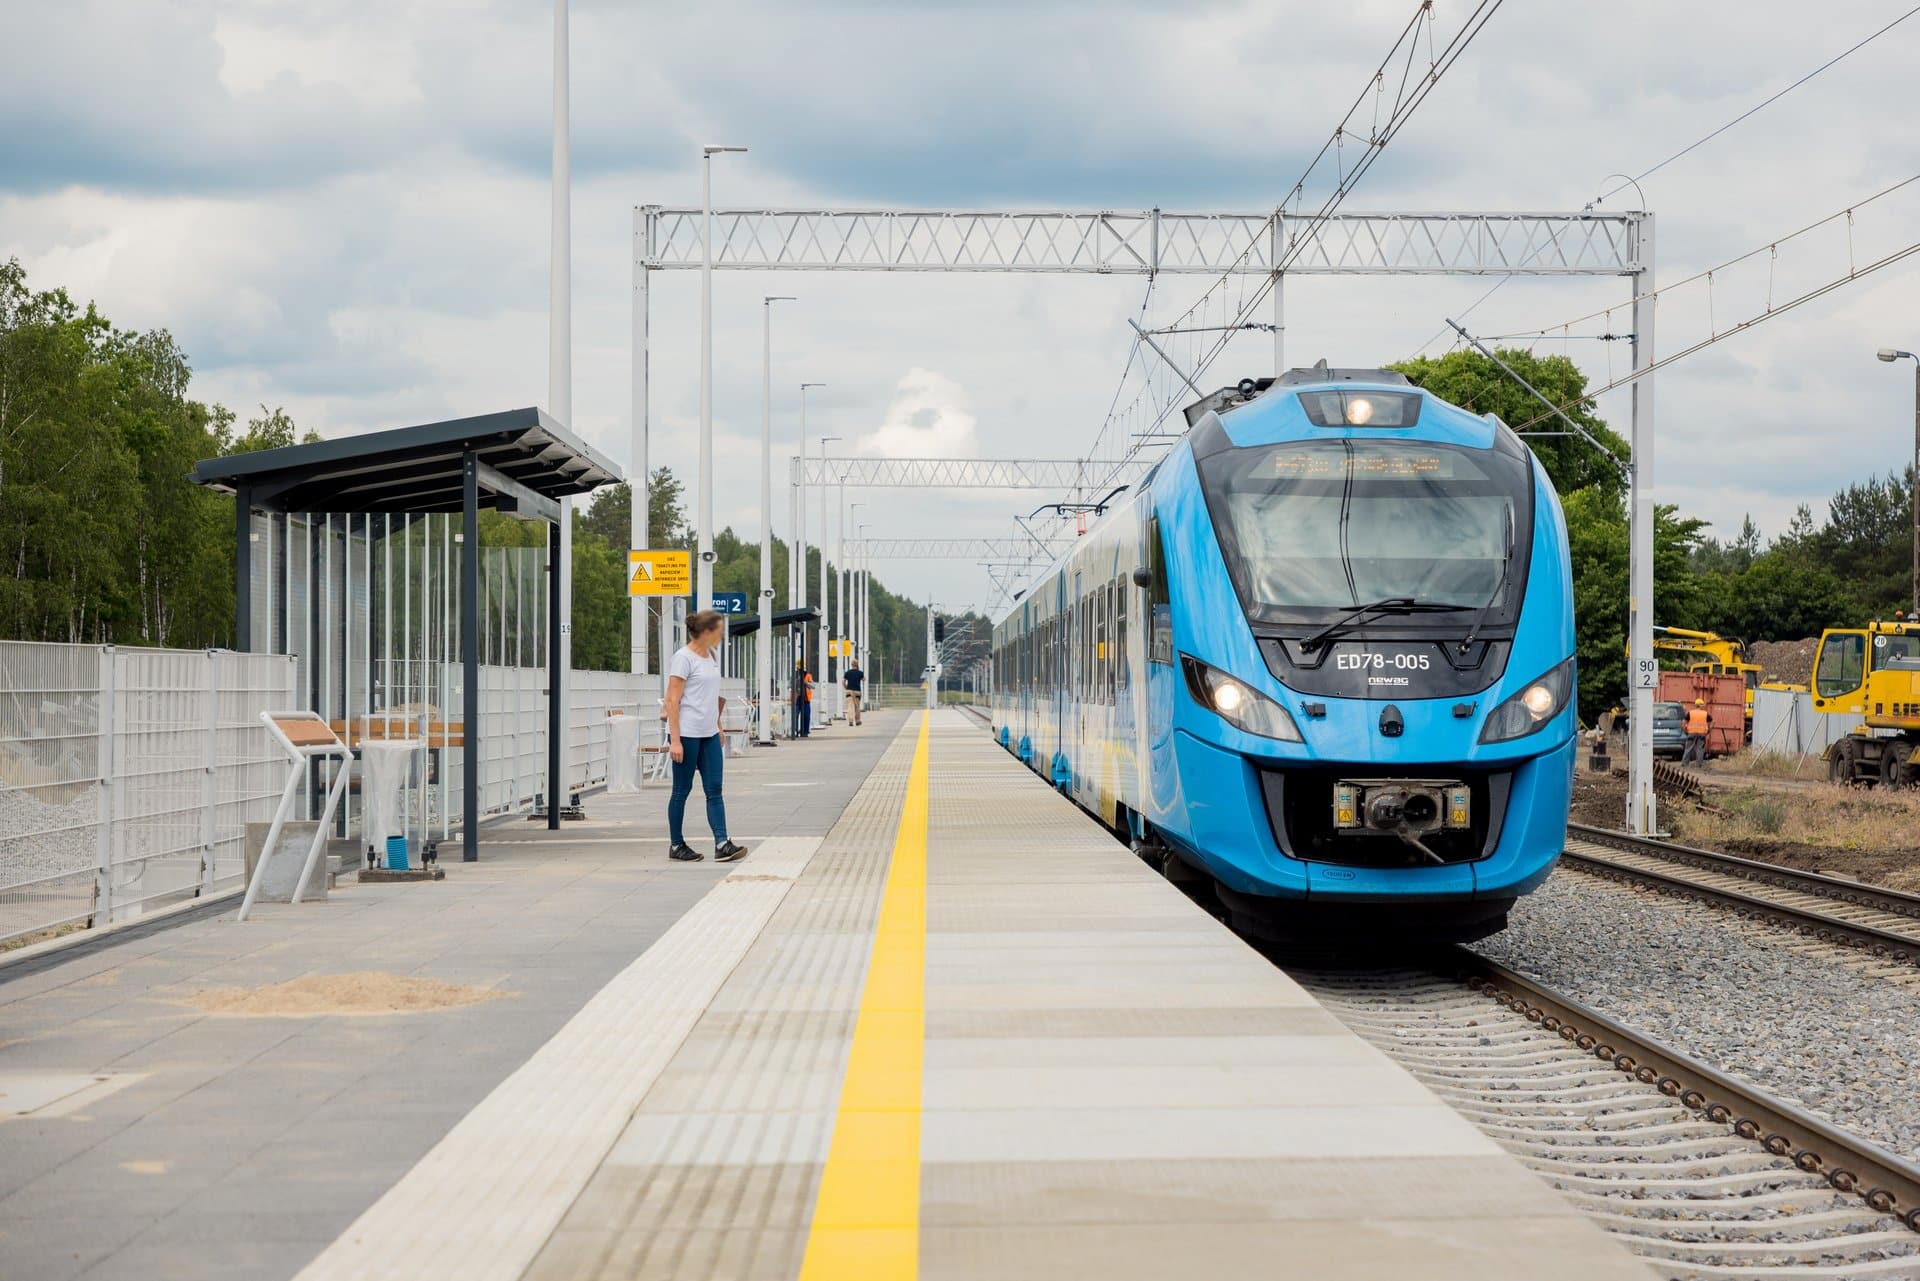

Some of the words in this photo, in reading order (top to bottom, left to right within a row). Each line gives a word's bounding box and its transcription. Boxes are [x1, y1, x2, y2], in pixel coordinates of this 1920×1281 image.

[732, 598, 741, 611] 2
[1337, 654, 1429, 670] ED78-005
[1640, 661, 1654, 671] 90
[1643, 674, 1651, 686] 2
